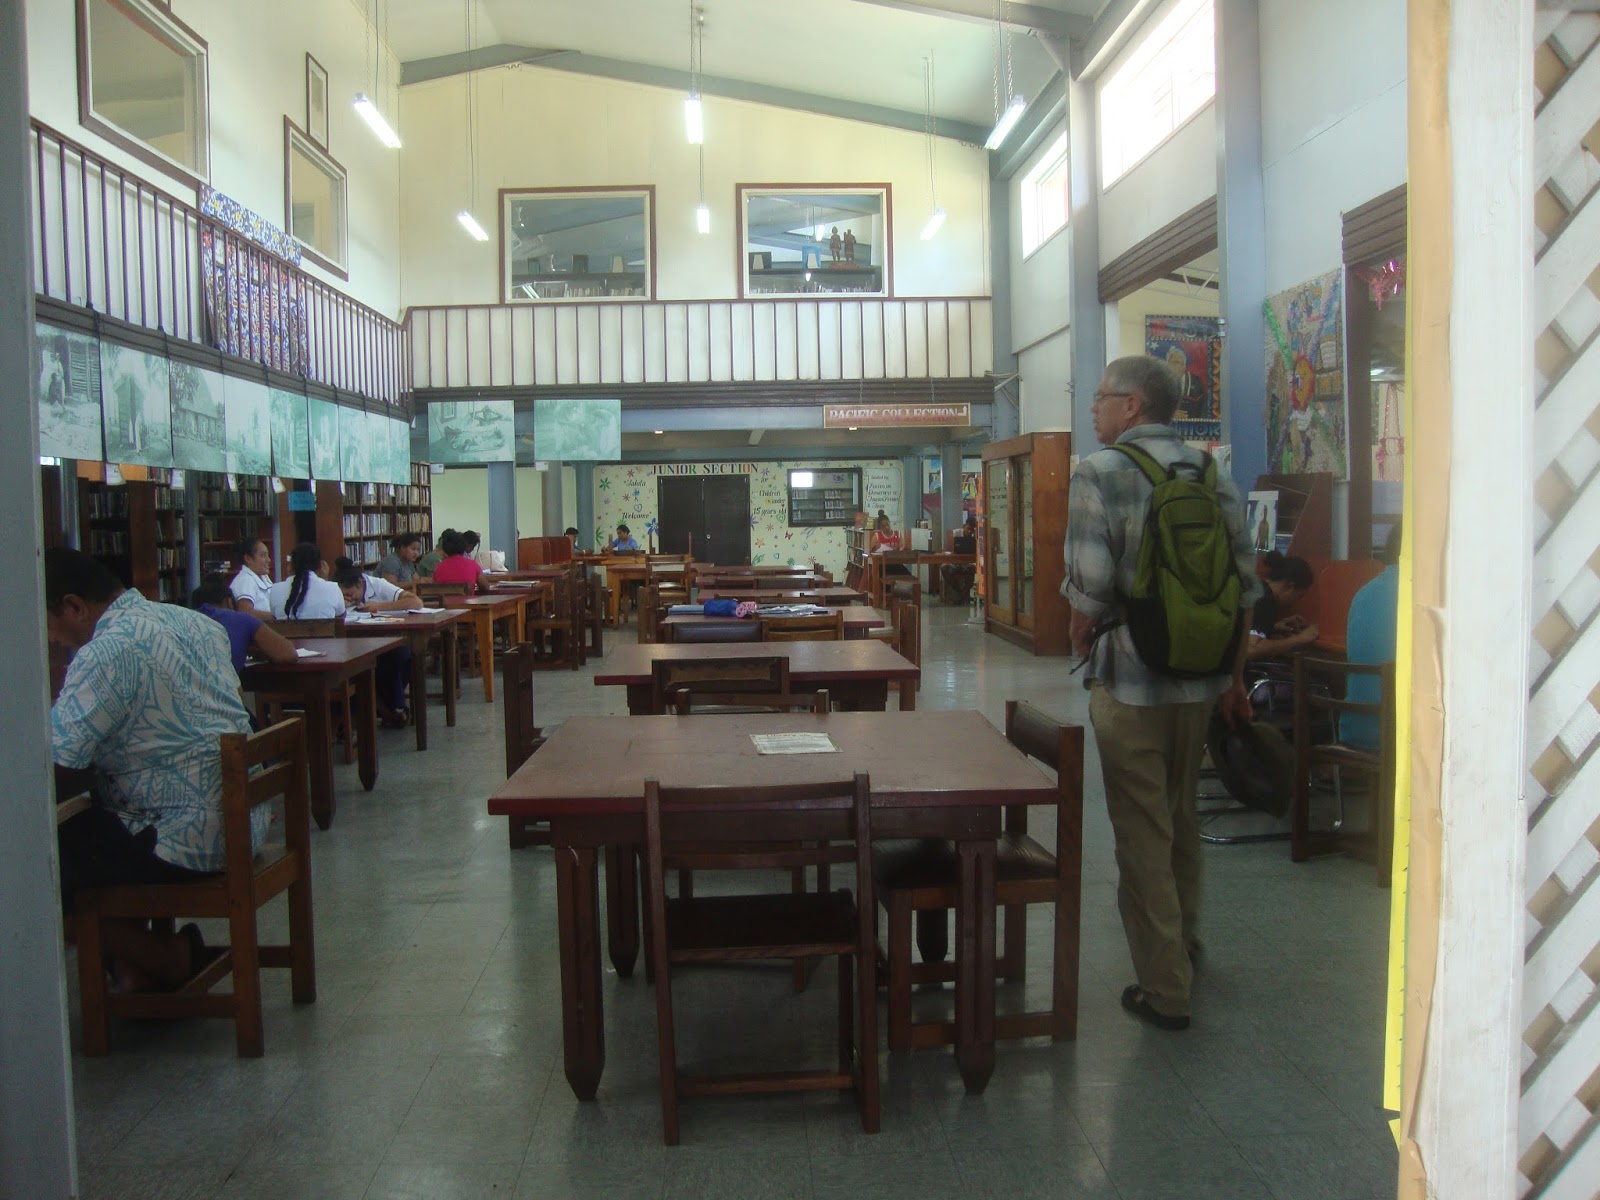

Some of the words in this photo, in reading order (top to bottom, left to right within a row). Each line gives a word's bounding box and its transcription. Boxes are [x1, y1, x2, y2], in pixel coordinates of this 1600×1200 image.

[830, 409, 878, 421] PACIFIC
[882, 408, 957, 420] COLLECTION
[651, 465, 697, 475] JUNIOR
[703, 464, 759, 474] SECTION
[753, 507, 761, 515] 15
